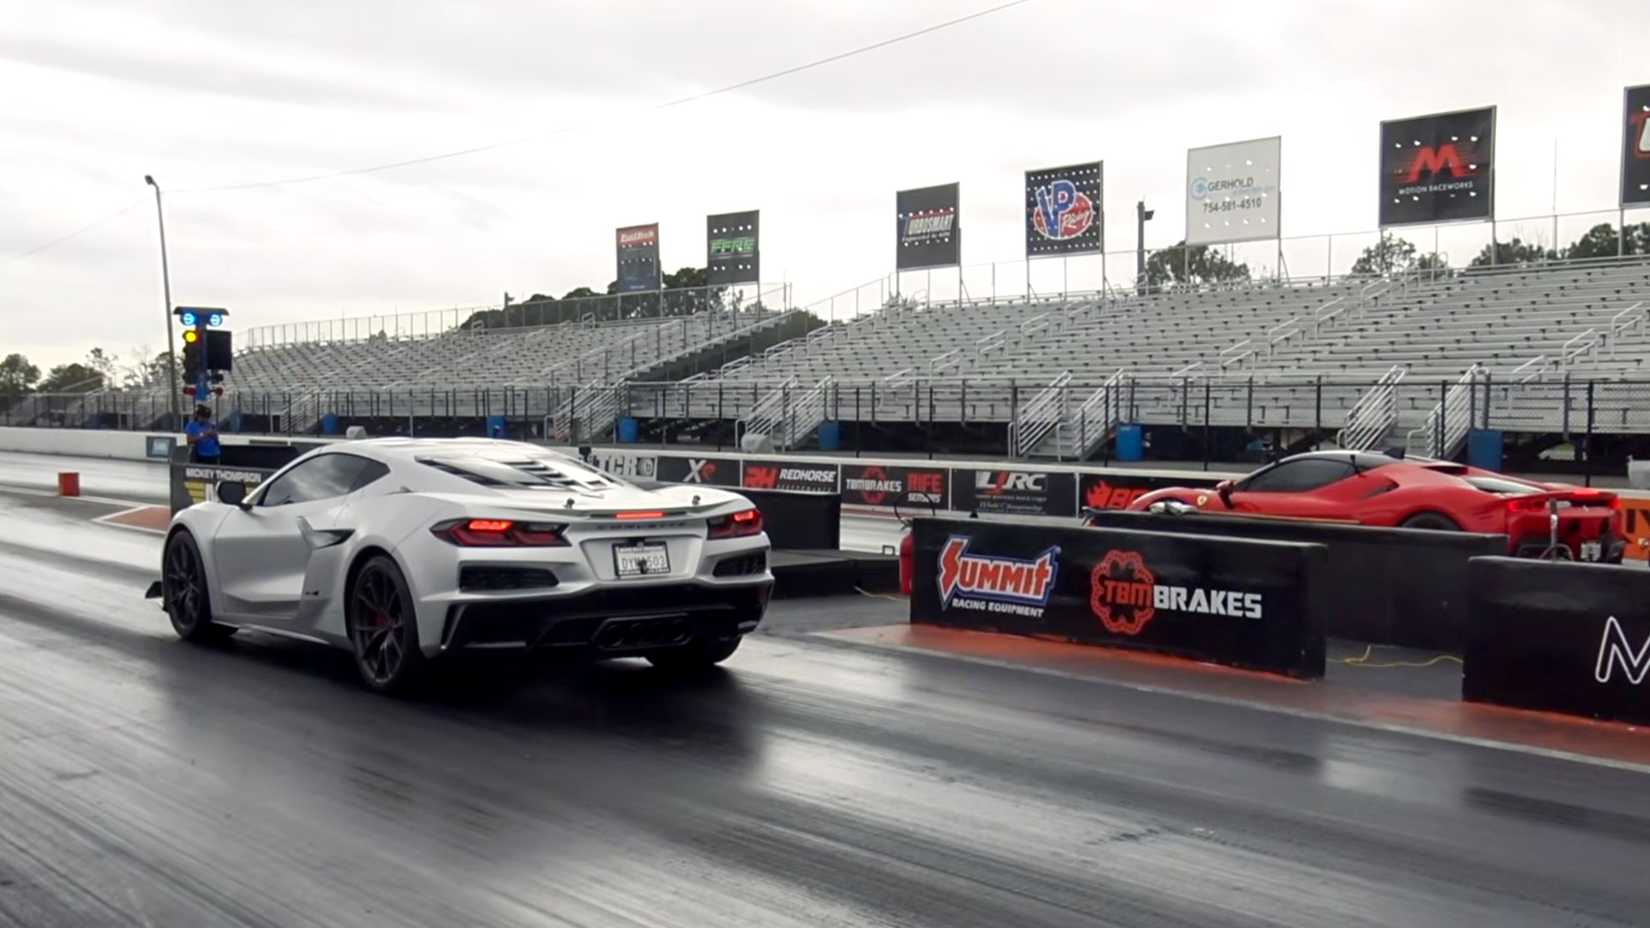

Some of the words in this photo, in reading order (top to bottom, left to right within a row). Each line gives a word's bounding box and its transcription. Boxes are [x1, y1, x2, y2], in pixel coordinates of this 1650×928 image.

[1208, 177, 1254, 192] GERHOLD
[779, 468, 836, 482] REDHORSE
[952, 598, 986, 611] RACING
[988, 601, 1045, 618] EQUIPMENT
